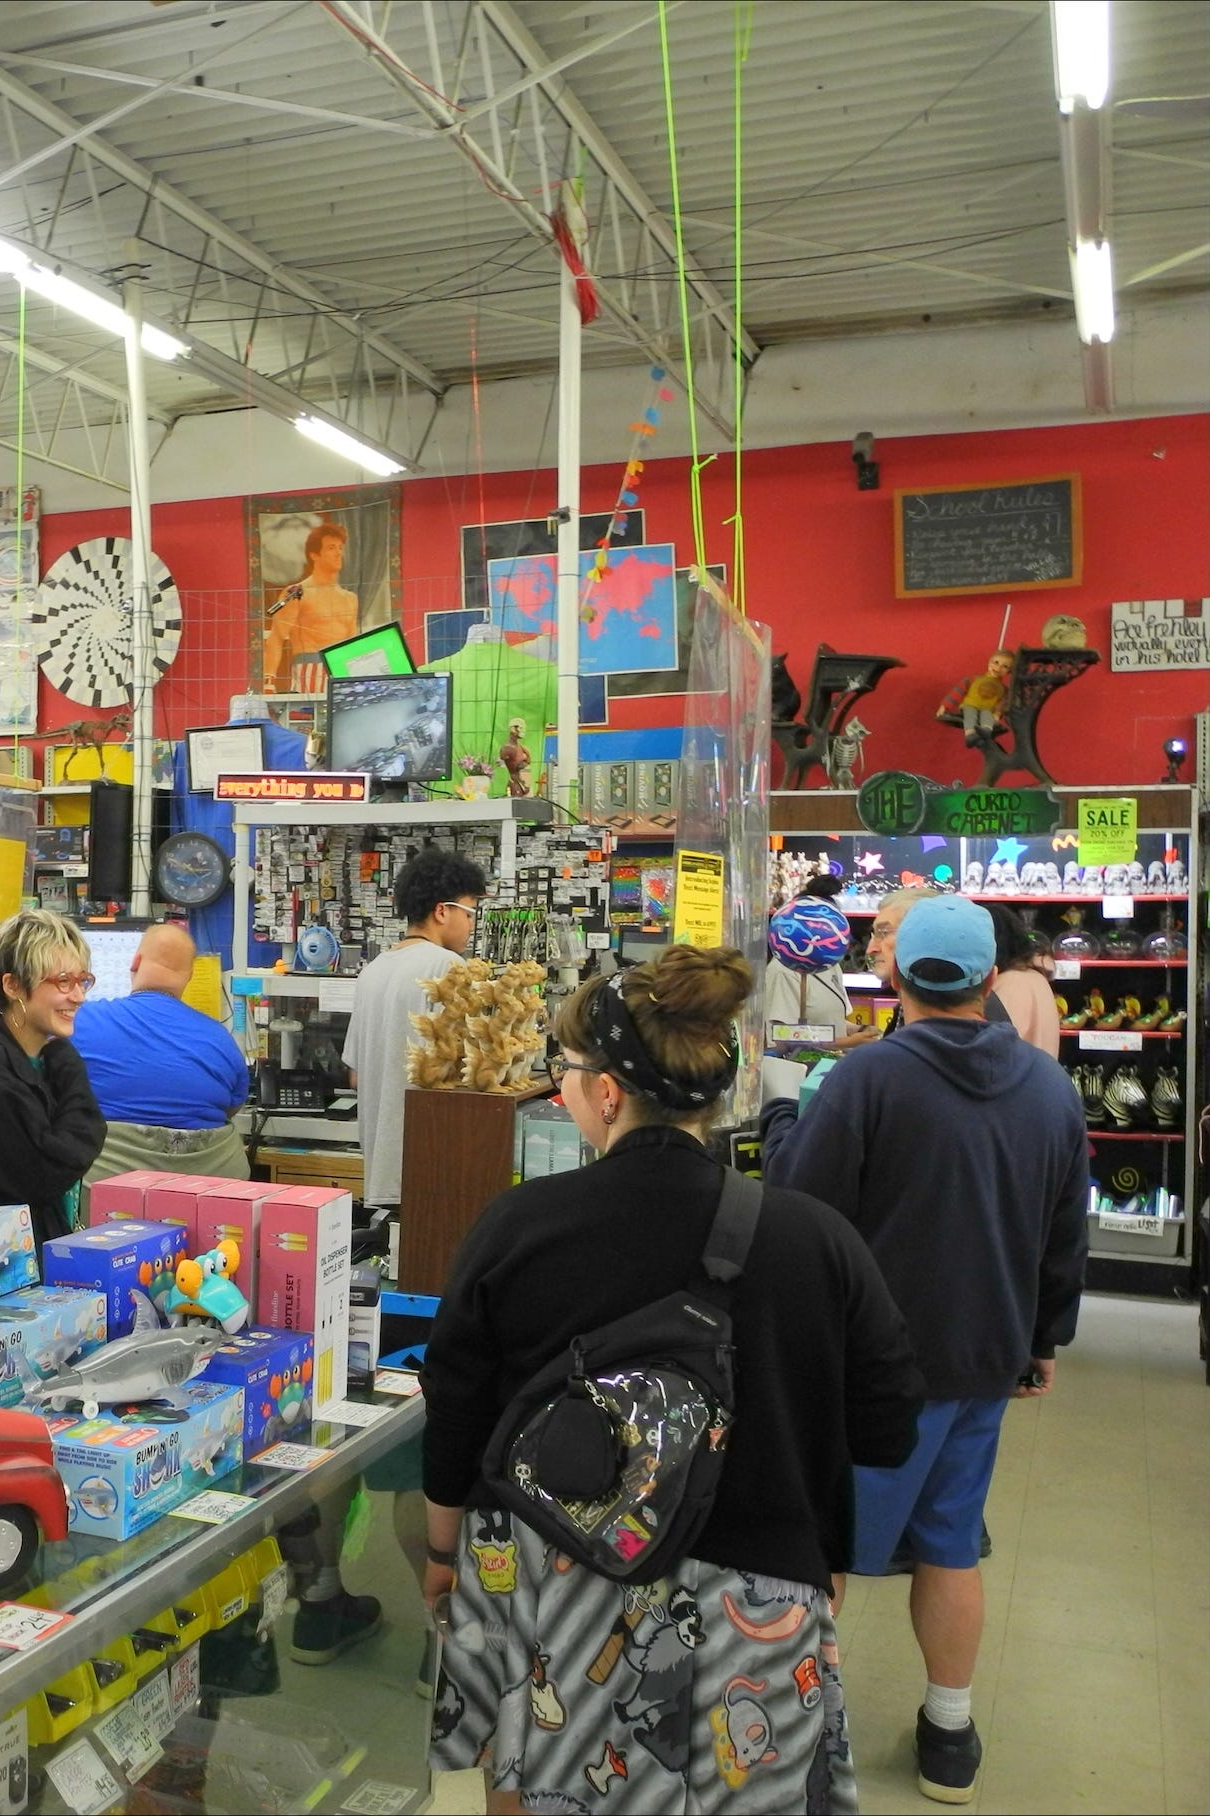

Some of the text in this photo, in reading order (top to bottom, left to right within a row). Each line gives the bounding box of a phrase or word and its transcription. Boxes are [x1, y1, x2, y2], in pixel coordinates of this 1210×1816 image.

[864, 779, 1022, 829] THE CURIO
[946, 812, 1038, 835] CABINET
[1086, 809, 1130, 826] SALE
[112, 1255, 137, 1269] CUTE CRAB
[286, 1273, 294, 1291] SET
[10, 1330, 23, 1346] GO
[136, 1446, 158, 1465] BUMP
[169, 1431, 180, 1448] GO
[0, 1735, 21, 1753] TRUE
